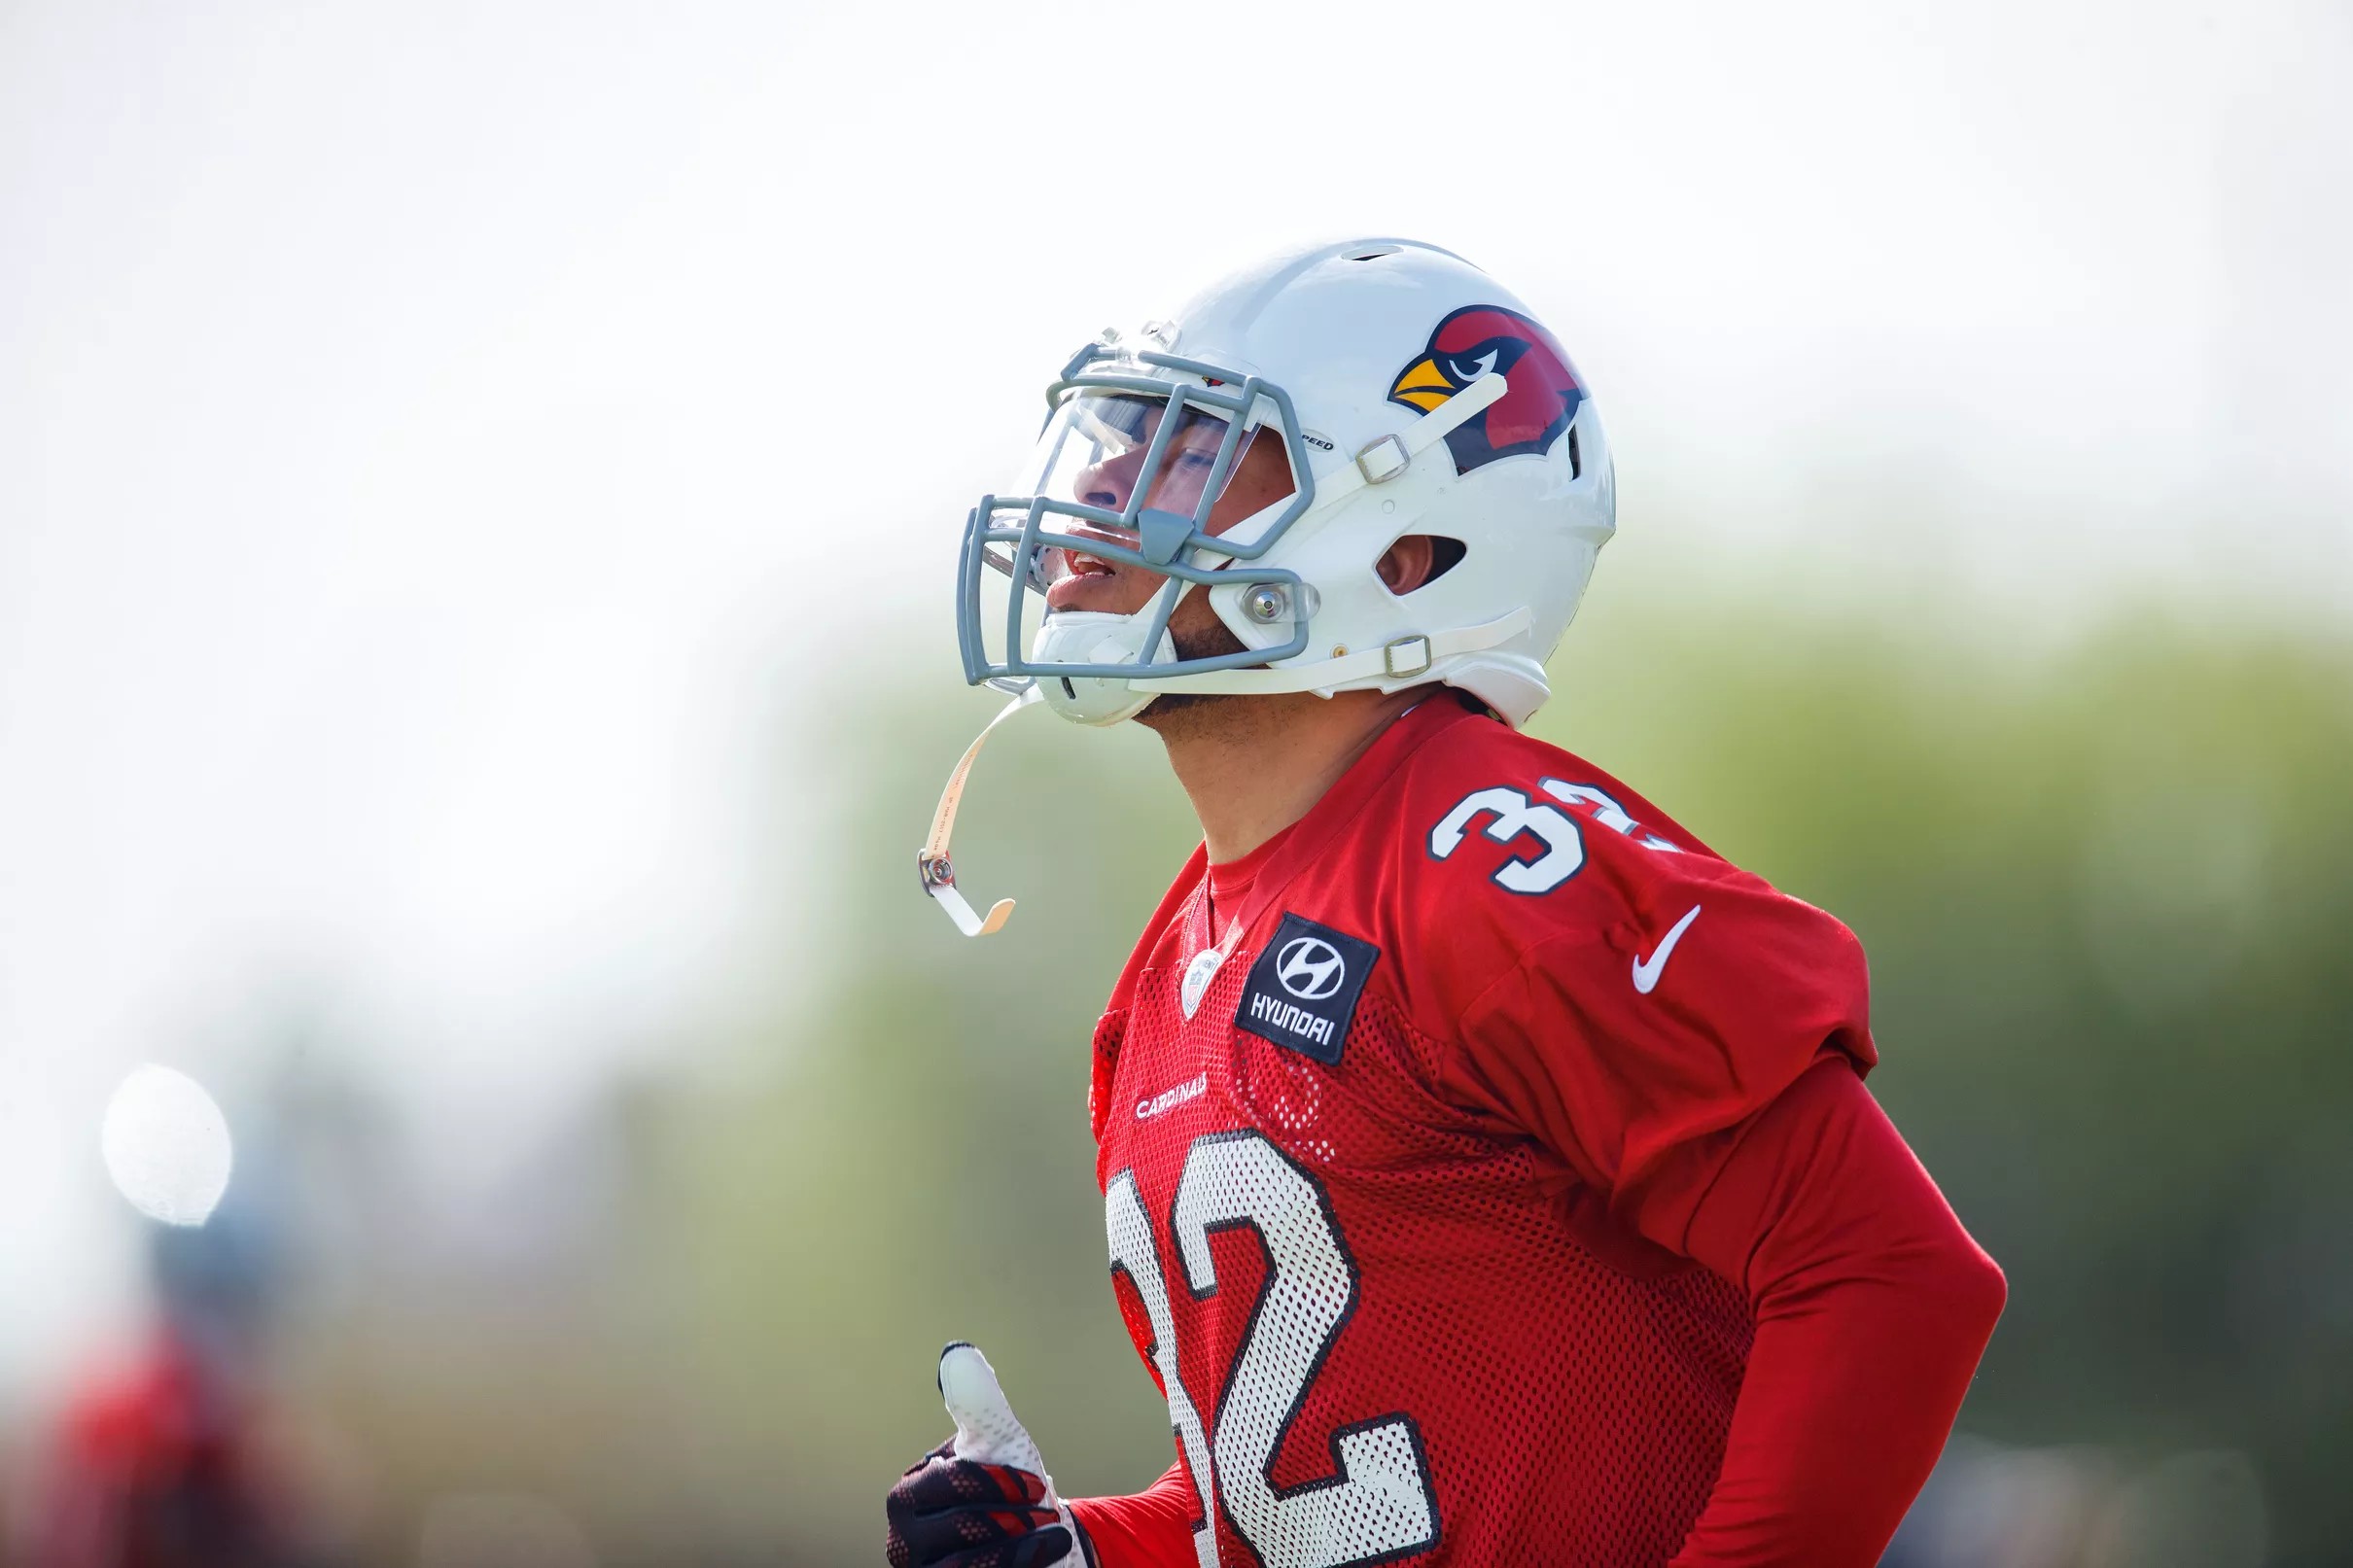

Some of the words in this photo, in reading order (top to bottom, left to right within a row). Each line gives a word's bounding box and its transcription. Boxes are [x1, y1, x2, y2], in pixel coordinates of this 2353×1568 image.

[1301, 434, 1334, 451] PEED
[1250, 992, 1336, 1046] HYUNDAI
[1136, 1071, 1209, 1119] CARDINALS
